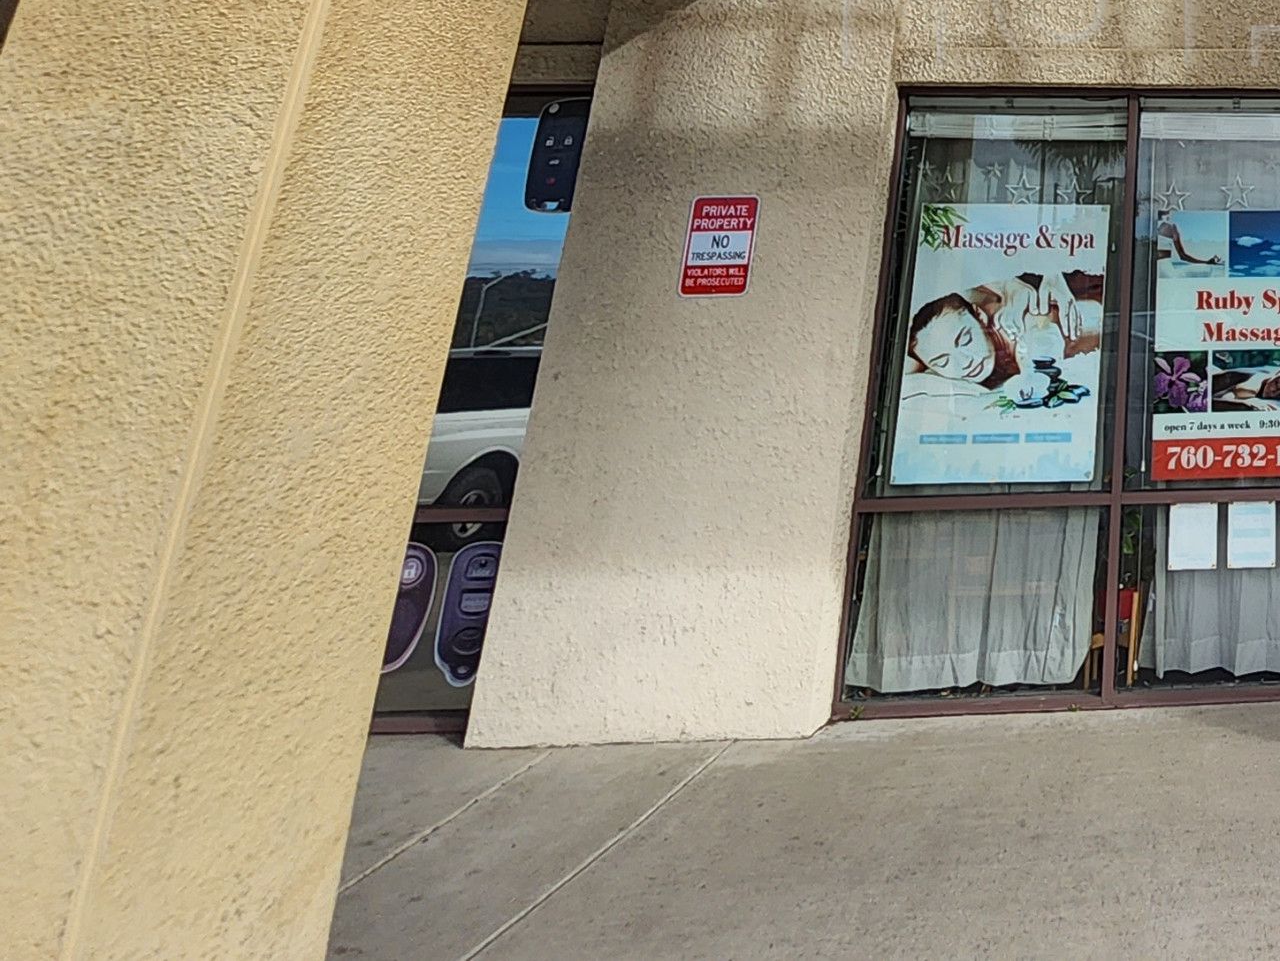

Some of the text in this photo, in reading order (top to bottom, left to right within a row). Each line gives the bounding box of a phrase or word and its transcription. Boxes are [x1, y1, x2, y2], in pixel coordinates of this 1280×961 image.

[702, 205, 750, 217] PRIVATE
[693, 218, 754, 230] PROPERTY
[711, 235, 731, 249] NO
[941, 225, 1096, 256] Massage & spa
[691, 251, 746, 261] TRESPASSING
[686, 268, 746, 277] VIOLATORS WILL
[685, 277, 745, 287] BE PROSECUTED
[1195, 290, 1255, 315] Ruby
[1163, 424, 1187, 434] open
[1189, 422, 1196, 431] 7
[1197, 421, 1218, 433] days
[1227, 420, 1251, 430] week
